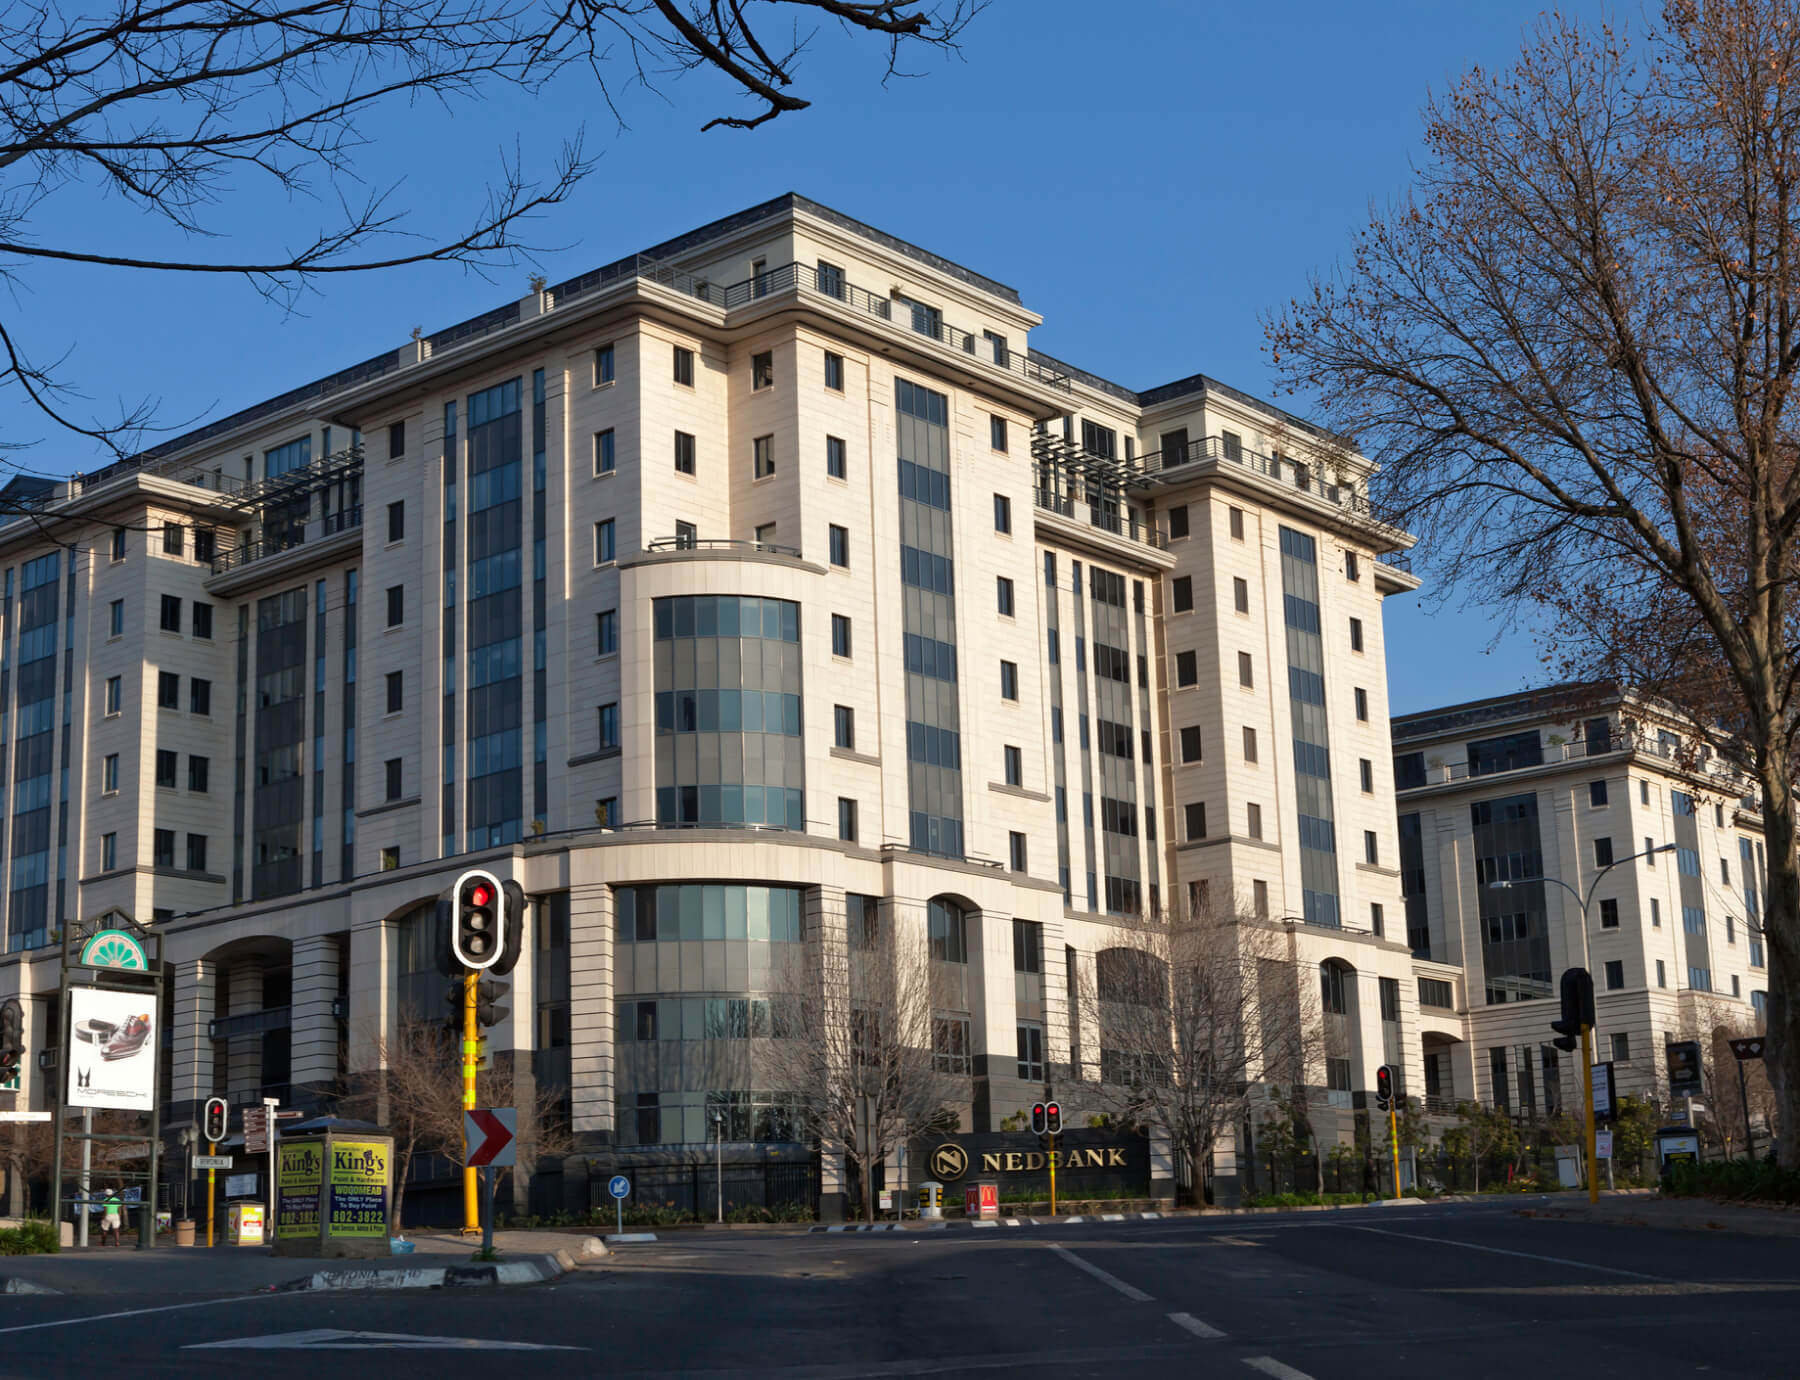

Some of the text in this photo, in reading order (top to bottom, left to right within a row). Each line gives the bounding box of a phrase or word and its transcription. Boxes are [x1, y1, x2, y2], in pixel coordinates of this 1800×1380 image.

[282, 1150, 320, 1176] King's
[334, 1150, 385, 1176] King's
[981, 1148, 1127, 1171] NEDBANK
[333, 1211, 383, 1223] 802-3822
